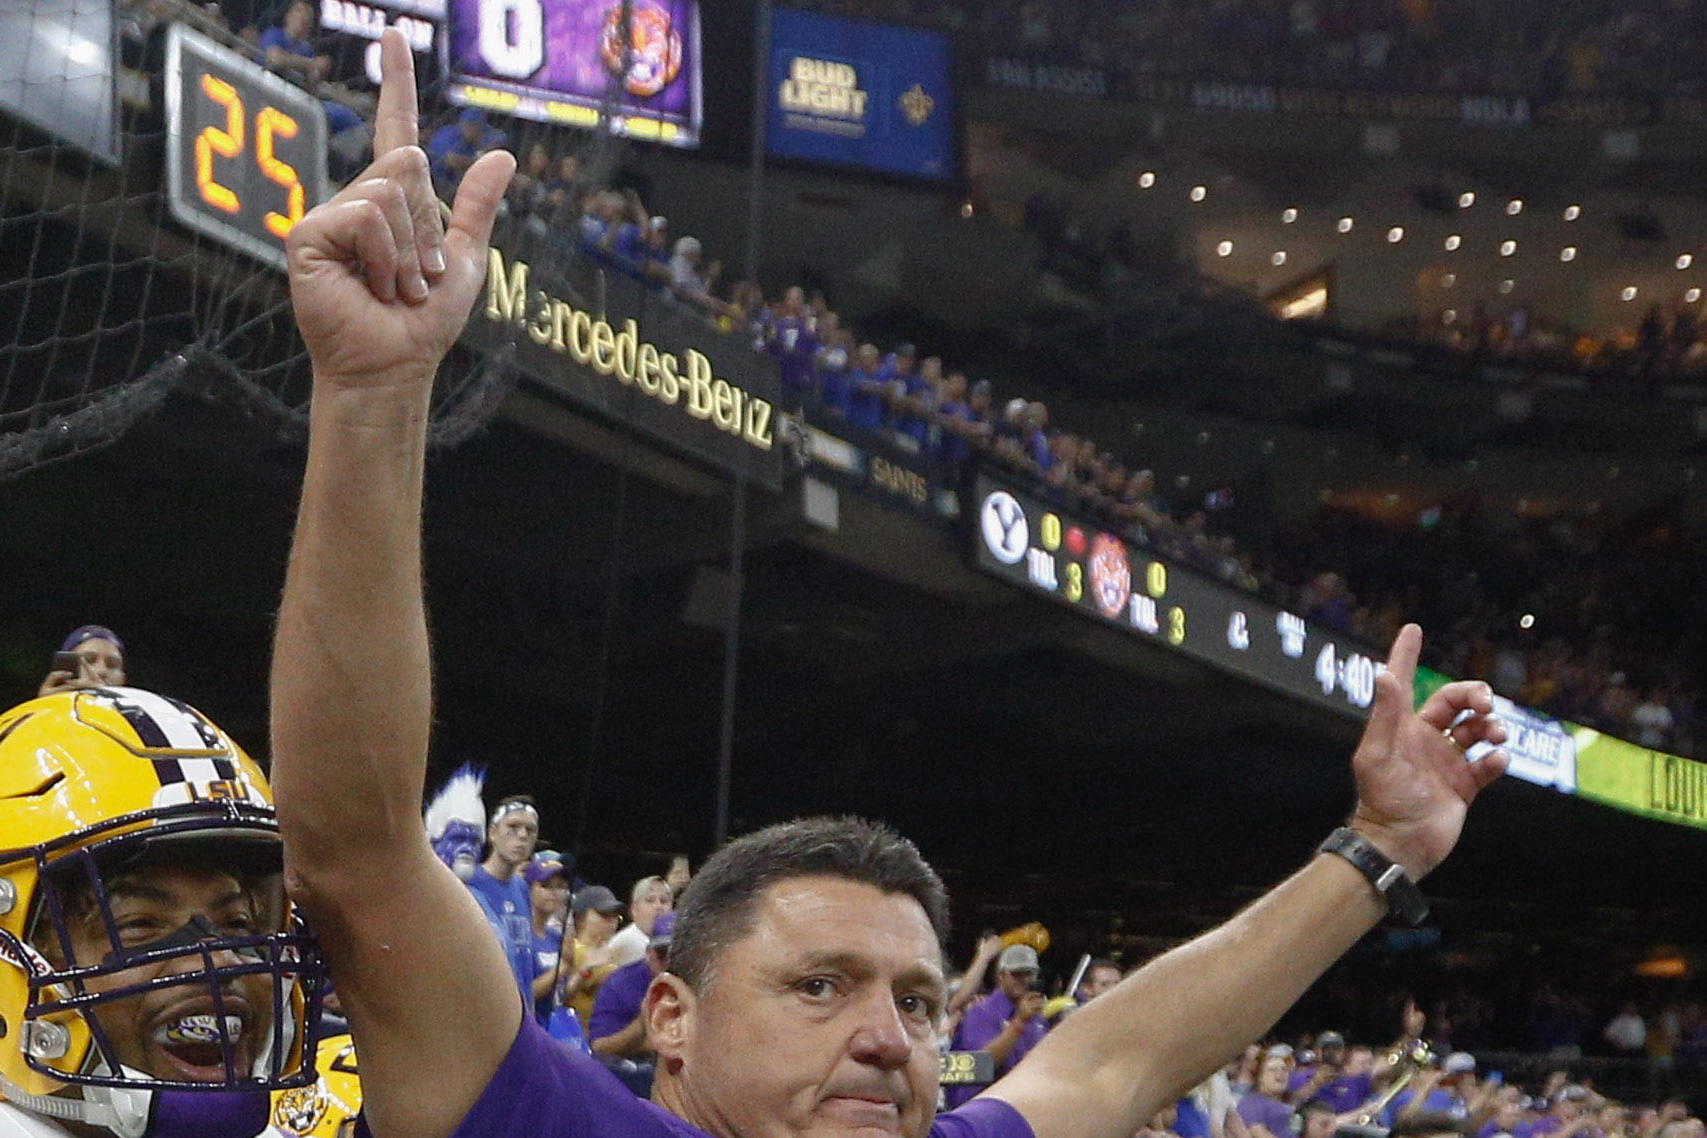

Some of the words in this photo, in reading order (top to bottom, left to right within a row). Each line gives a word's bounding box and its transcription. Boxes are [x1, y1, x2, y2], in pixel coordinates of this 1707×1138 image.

[790, 57, 857, 88] BUD
[779, 78, 867, 121] LIGHT
[195, 73, 306, 238] 25
[486, 247, 773, 450] Mercedes-Benz
[1040, 512, 1061, 551] 0
[1065, 562, 1083, 603] 3
[1146, 561, 1167, 599] 0
[1167, 606, 1186, 645] 3
[1315, 642, 1374, 708] 4:40
[188, 781, 249, 802] LSU
